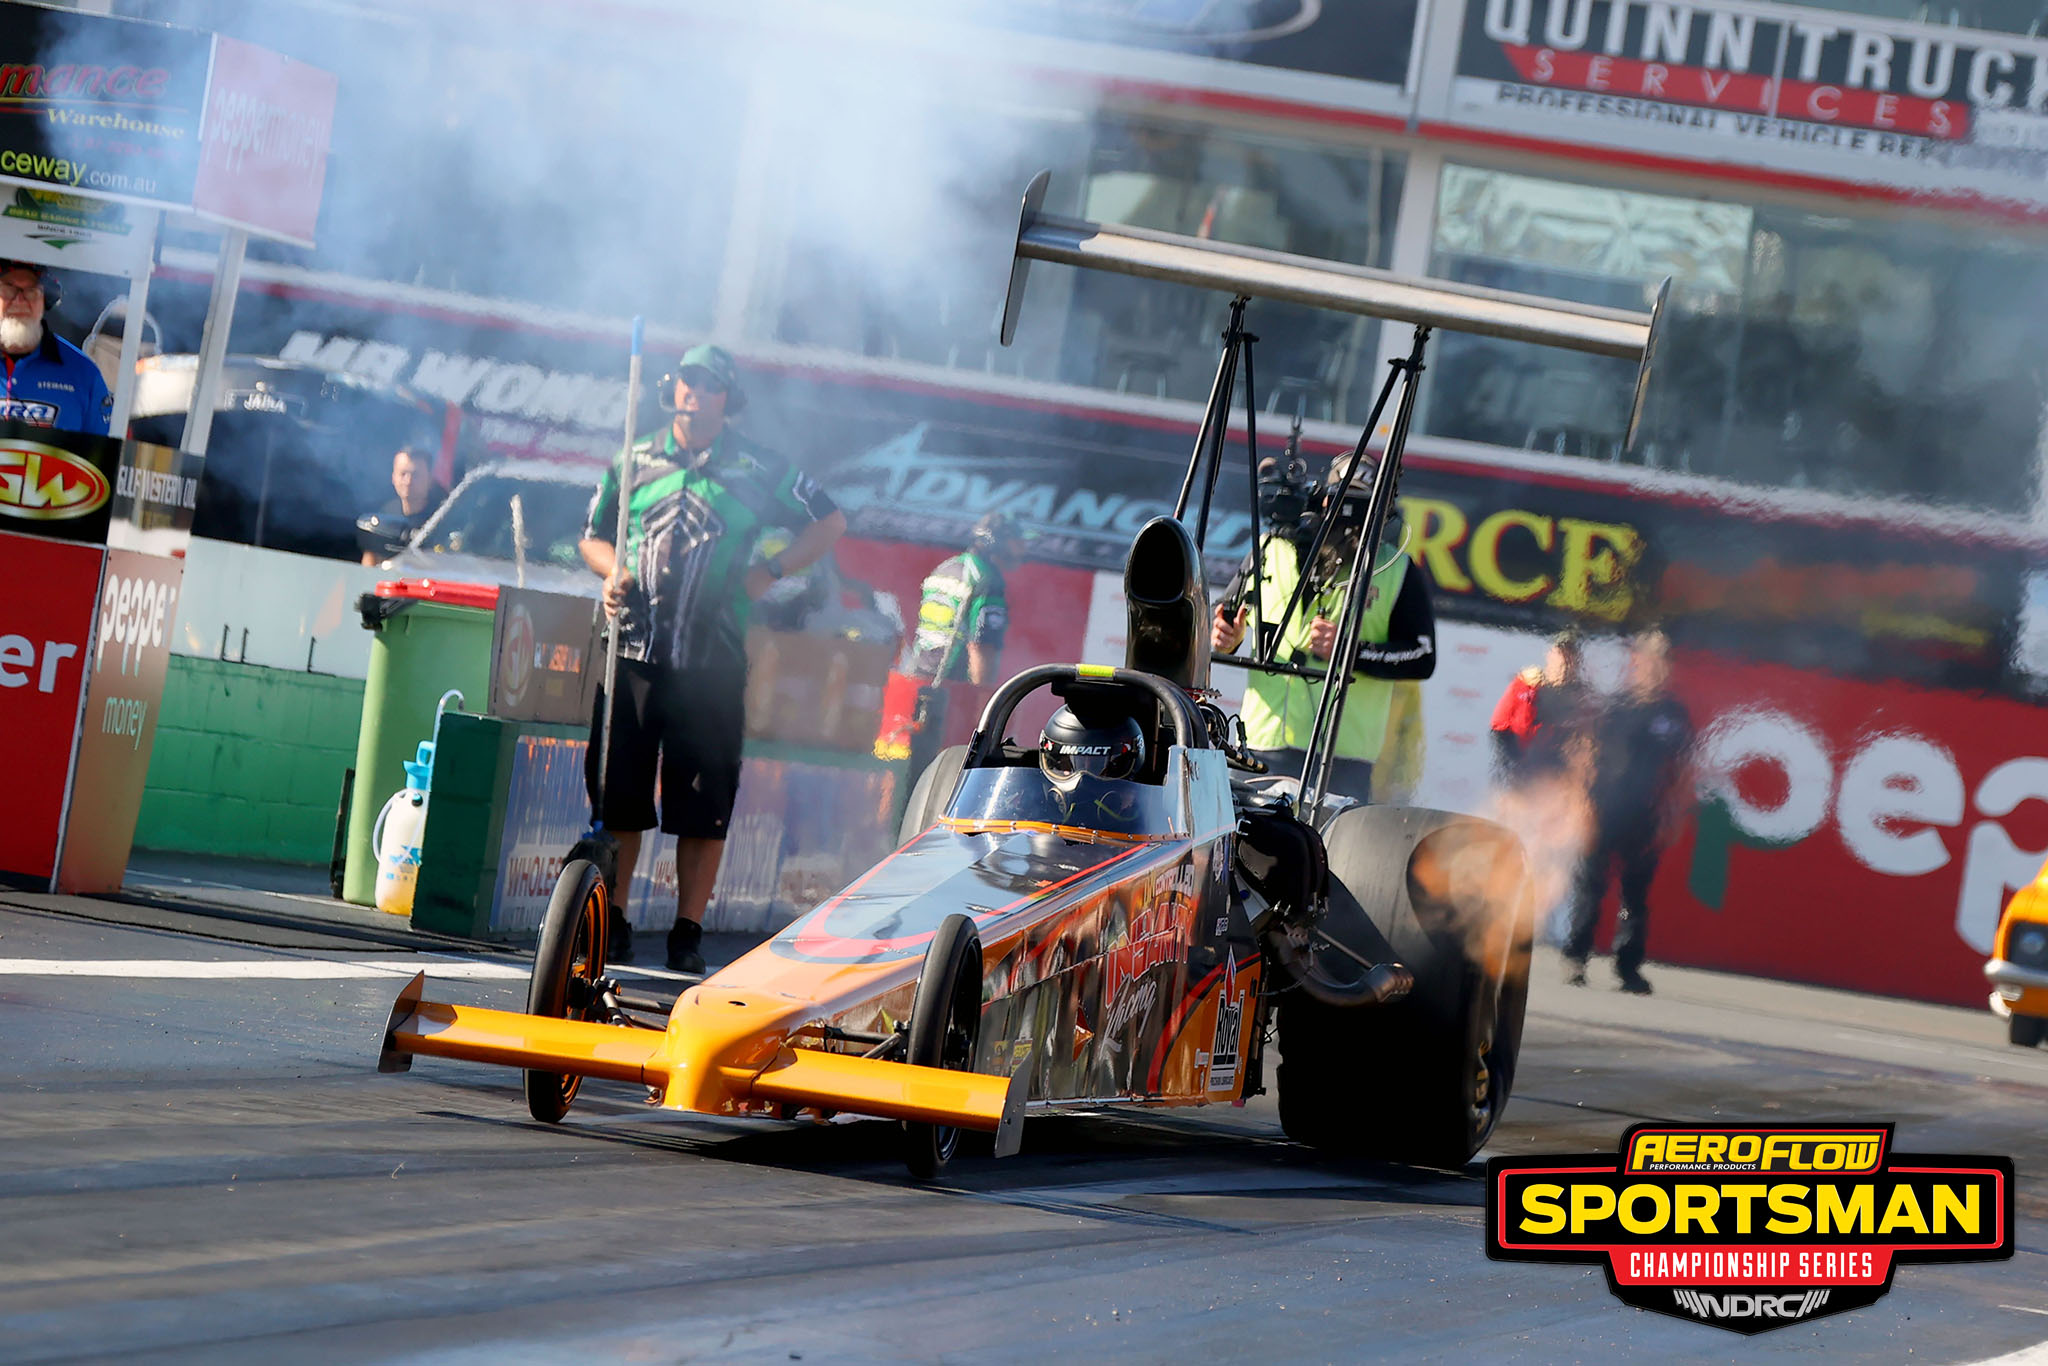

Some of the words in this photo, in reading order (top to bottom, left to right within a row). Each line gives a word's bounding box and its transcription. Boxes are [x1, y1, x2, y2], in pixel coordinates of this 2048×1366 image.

[1484, 0, 1756, 74] QUINN
[1533, 48, 1953, 138] SERVICES
[47, 108, 186, 140] Warehouse
[115, 464, 142, 500] GULF
[141, 468, 184, 508] WESTERN
[96, 574, 176, 678] pepper
[102, 696, 148, 750] money
[1059, 744, 1112, 756] IMPACT
